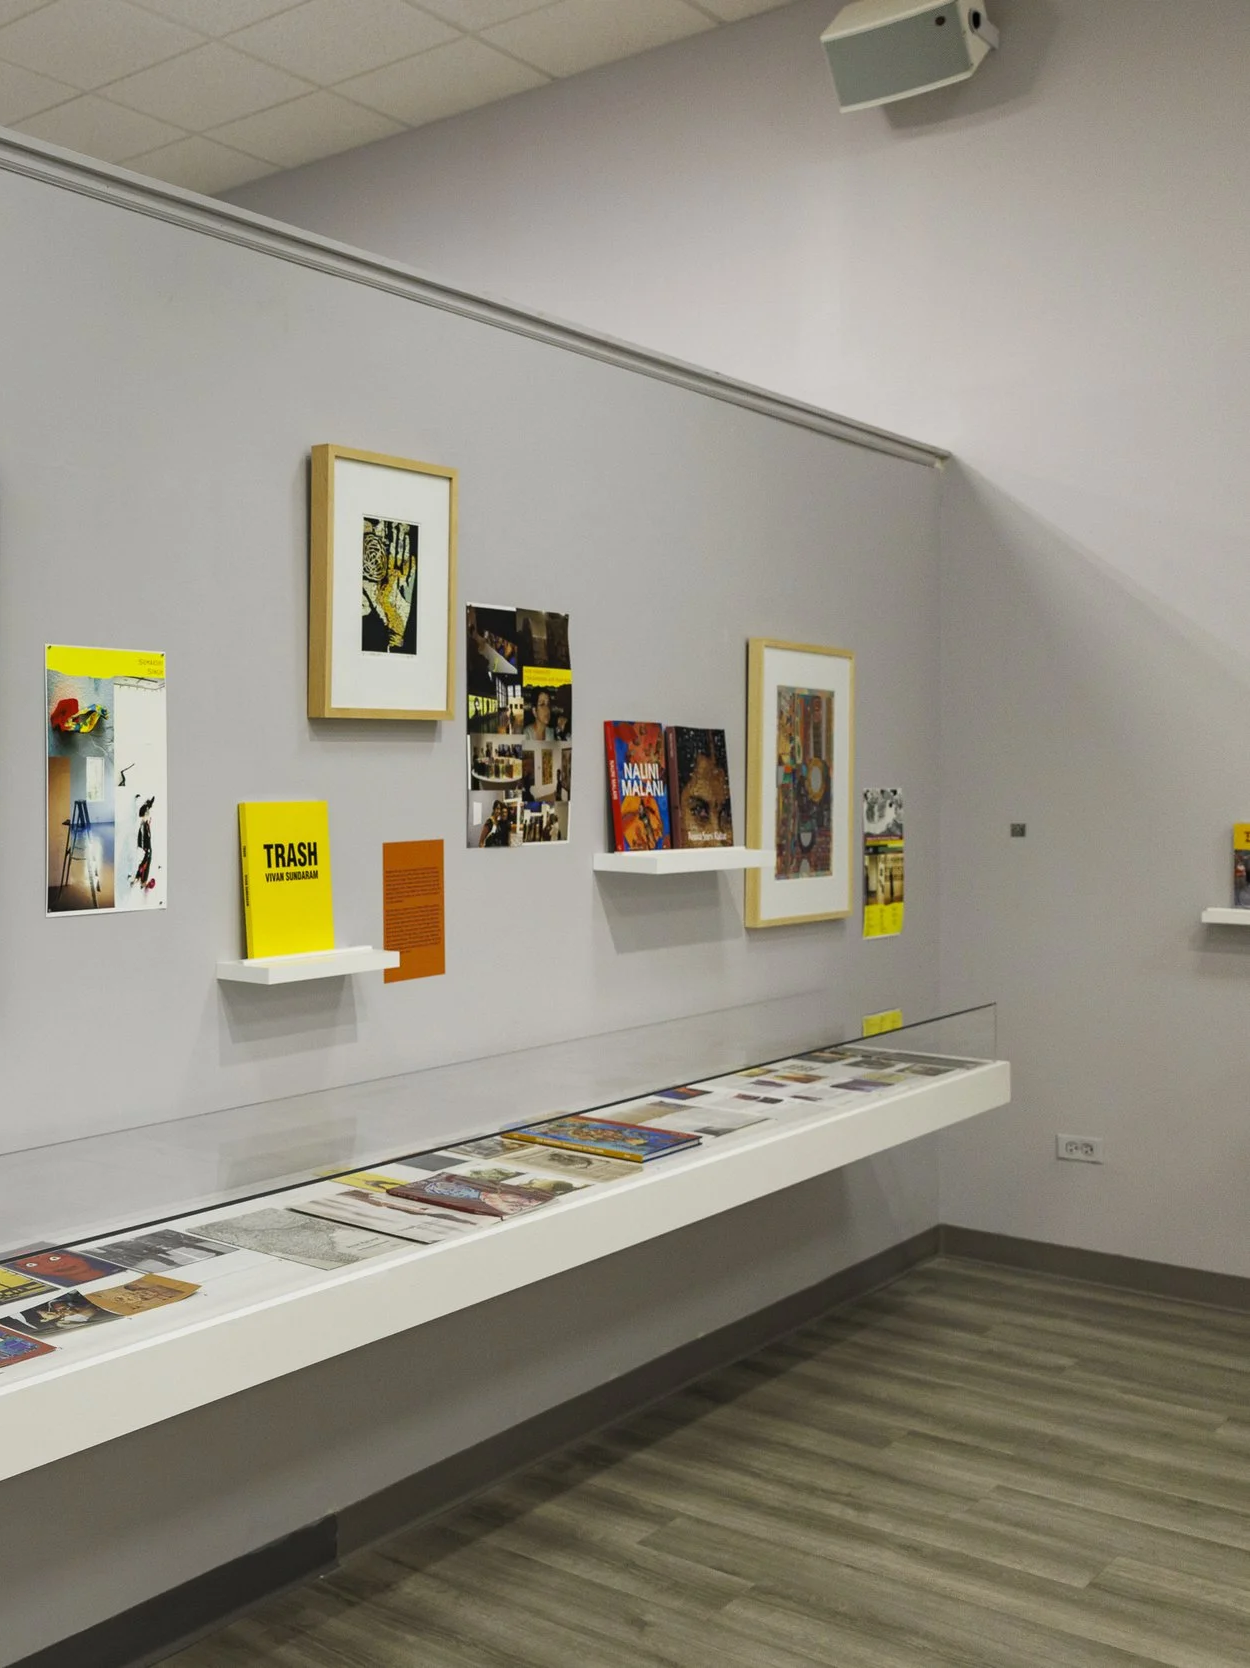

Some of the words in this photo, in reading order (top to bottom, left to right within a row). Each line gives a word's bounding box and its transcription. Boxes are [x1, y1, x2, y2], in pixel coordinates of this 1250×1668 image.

[623, 762, 659, 779] NALINI
[621, 780, 664, 796] MALANI
[263, 841, 318, 868] TRASH
[265, 872, 284, 883] VIVAN
[285, 870, 318, 881] SUNDARAM
